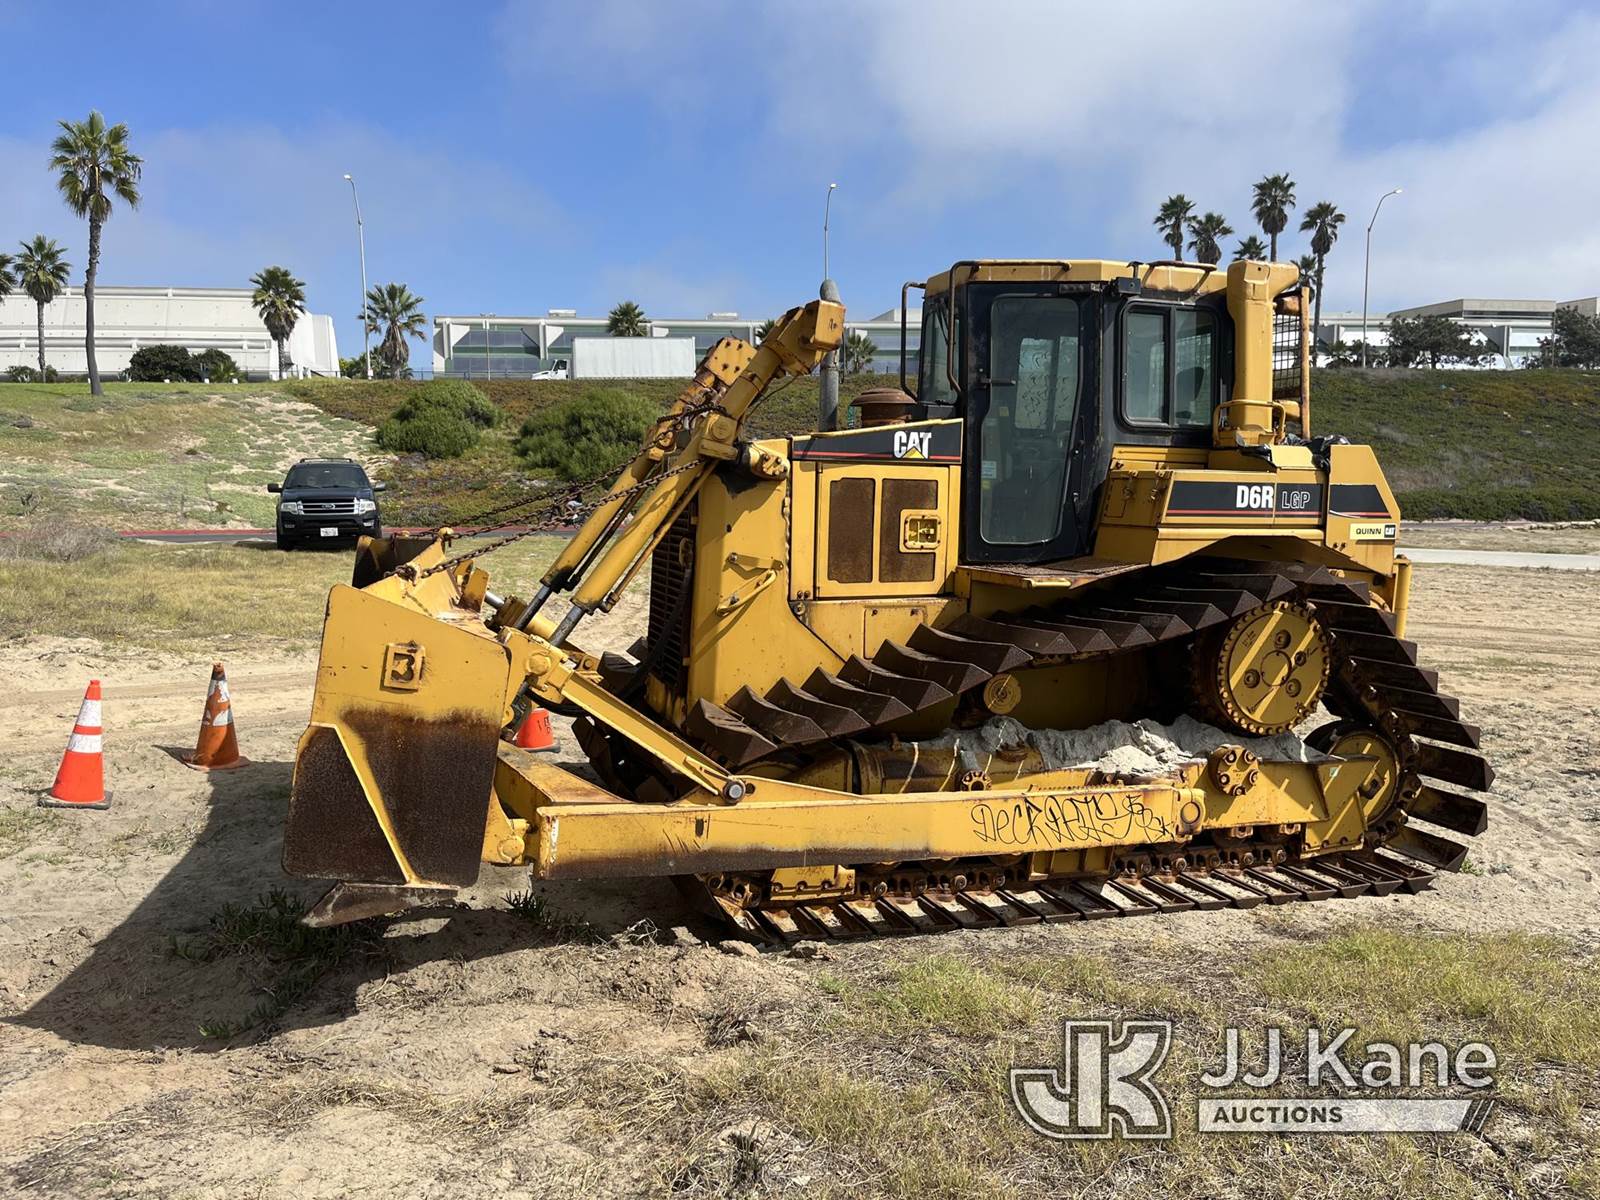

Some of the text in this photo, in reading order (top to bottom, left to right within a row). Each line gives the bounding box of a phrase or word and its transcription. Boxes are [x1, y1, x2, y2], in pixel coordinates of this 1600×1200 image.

[893, 430, 932, 459] CAT
[1235, 485, 1311, 509] D6R LGP
[1355, 527, 1382, 535] QUINN
